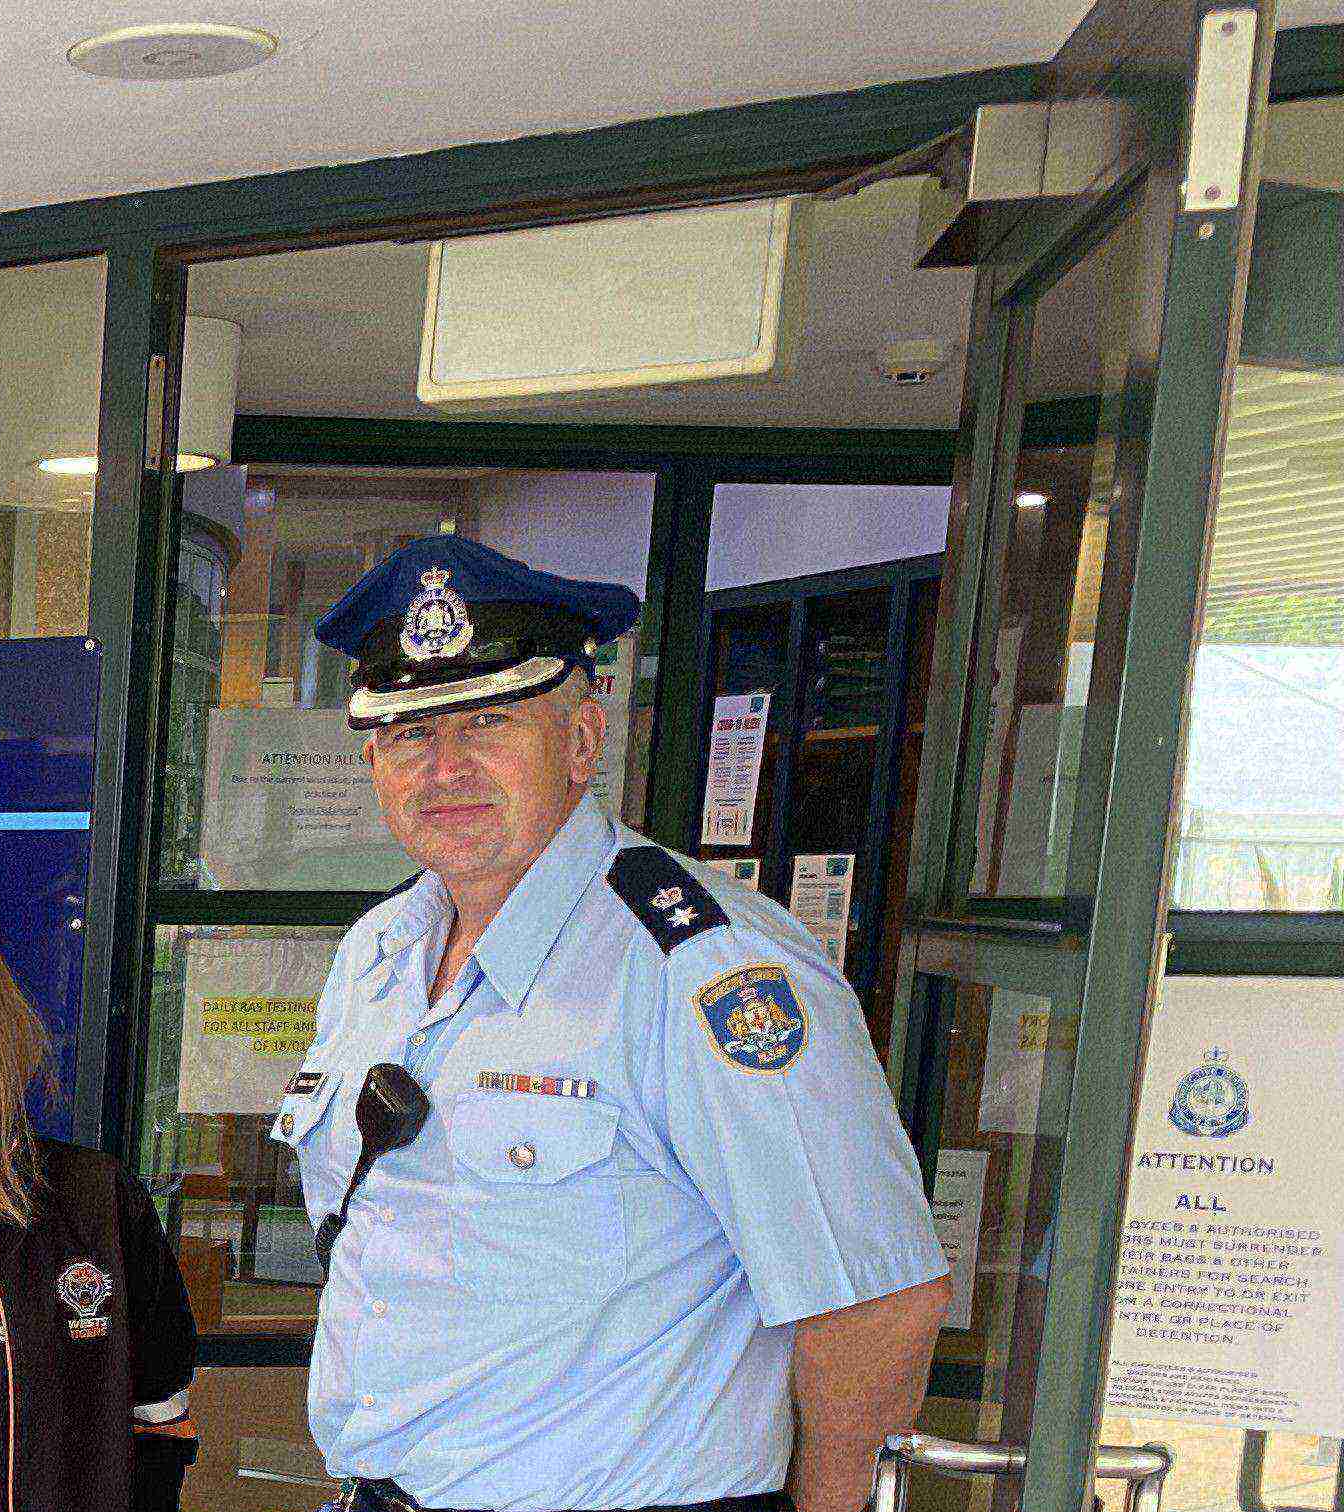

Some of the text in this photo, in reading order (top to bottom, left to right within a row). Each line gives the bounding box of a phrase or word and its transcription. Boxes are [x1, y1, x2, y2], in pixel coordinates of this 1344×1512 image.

[262, 753, 330, 765] ATTENTION
[203, 1001, 237, 1013] DAILY
[266, 1001, 315, 1013] TESTING
[203, 1021, 227, 1032] FOR
[231, 1021, 251, 1032] ALL
[254, 1021, 289, 1032] STAFF
[253, 1040, 269, 1051] OF
[1137, 1153, 1275, 1174] ATTENTION
[1175, 1194, 1226, 1212] ALL
[1206, 1224, 1320, 1240] AUTHORISED
[1159, 1237, 1205, 1248] MUST
[1213, 1240, 1322, 1256] SURRENDER
[1161, 1252, 1206, 1264] BAGS
[1230, 1257, 1290, 1270] OTHER
[1198, 1270, 1231, 1282] FOR
[1237, 1274, 1308, 1288] SEARCH
[1153, 1283, 1208, 1295] ENTRY
[1213, 1286, 1236, 1298] TO
[1242, 1289, 1266, 1300] OR
[1272, 1292, 1311, 1303] EXIT
[1143, 1298, 1154, 1307] A
[1160, 1299, 1293, 1318] CORRECTIONAL
[1169, 1315, 1192, 1325] OR
[1198, 1317, 1256, 1331] PLACE
[1262, 1322, 1285, 1332] OF
